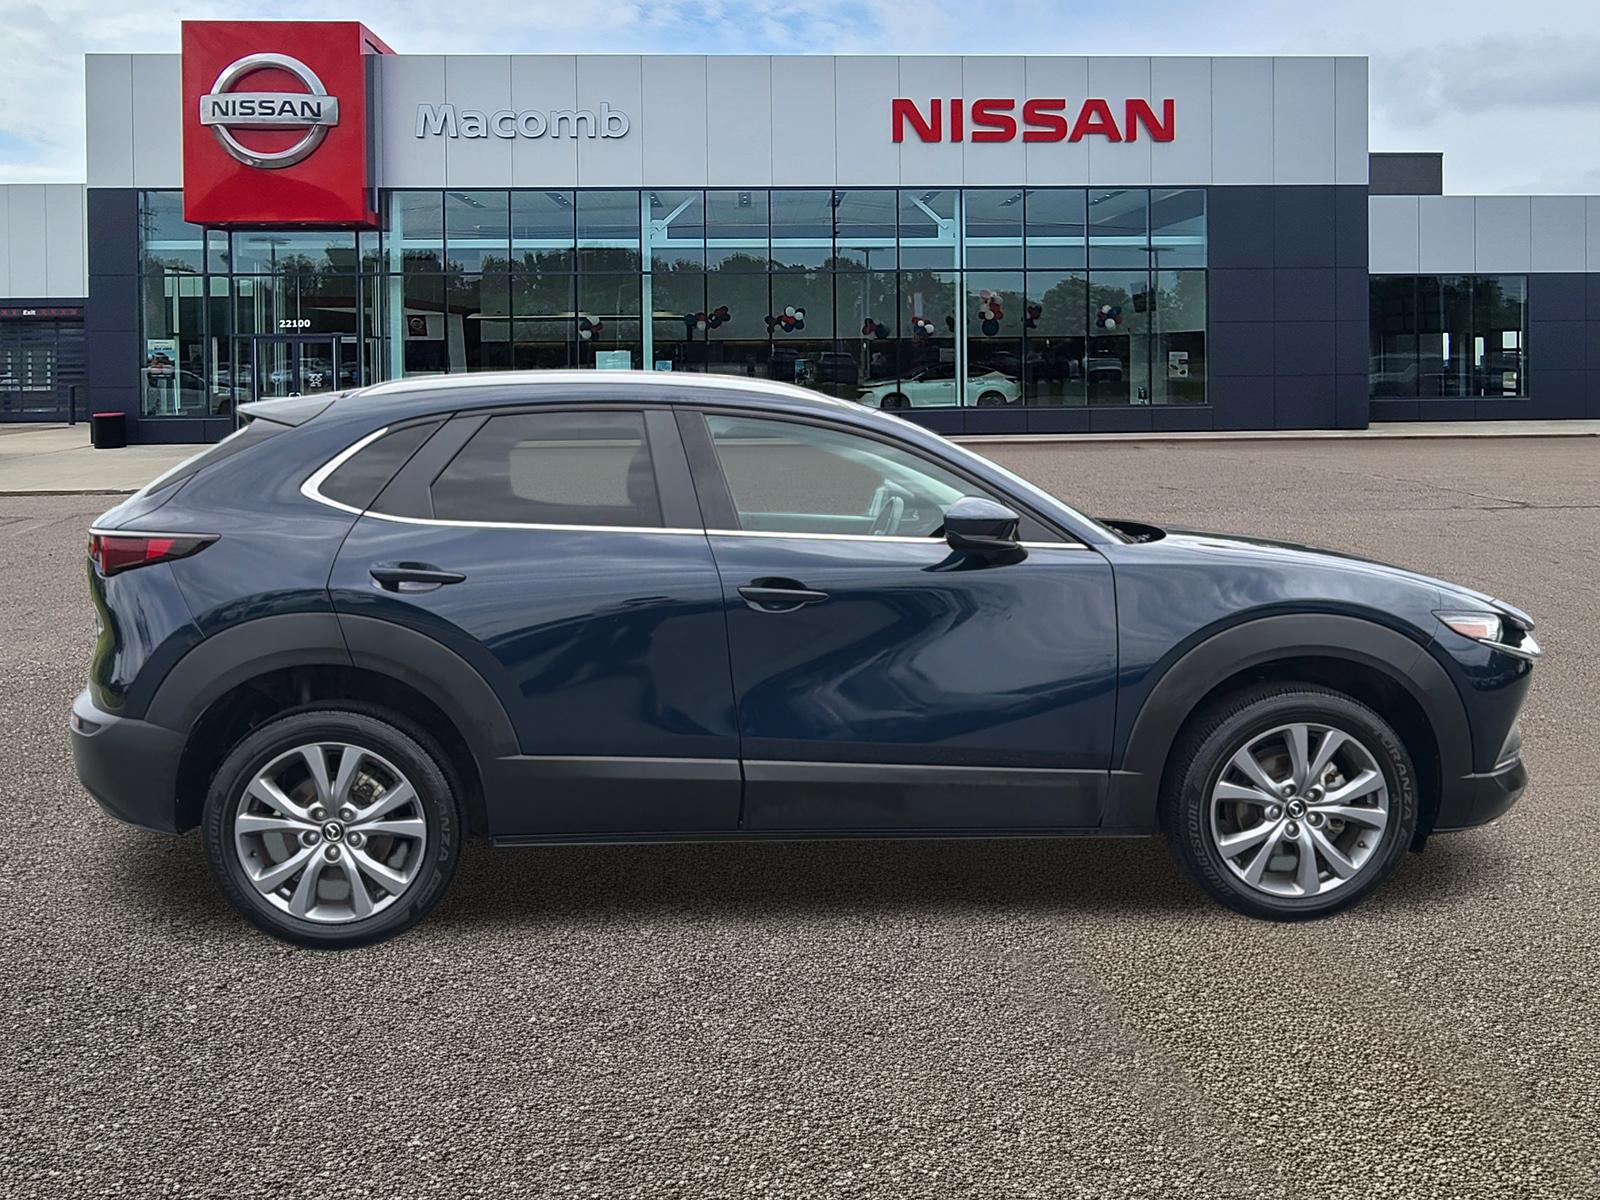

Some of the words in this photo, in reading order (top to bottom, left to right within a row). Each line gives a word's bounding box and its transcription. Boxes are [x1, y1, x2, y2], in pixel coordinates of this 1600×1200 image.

[212, 99, 322, 118] NISSAN
[415, 102, 630, 139] Macomb
[892, 98, 1175, 143] NISSAN
[279, 319, 311, 328] 22100
